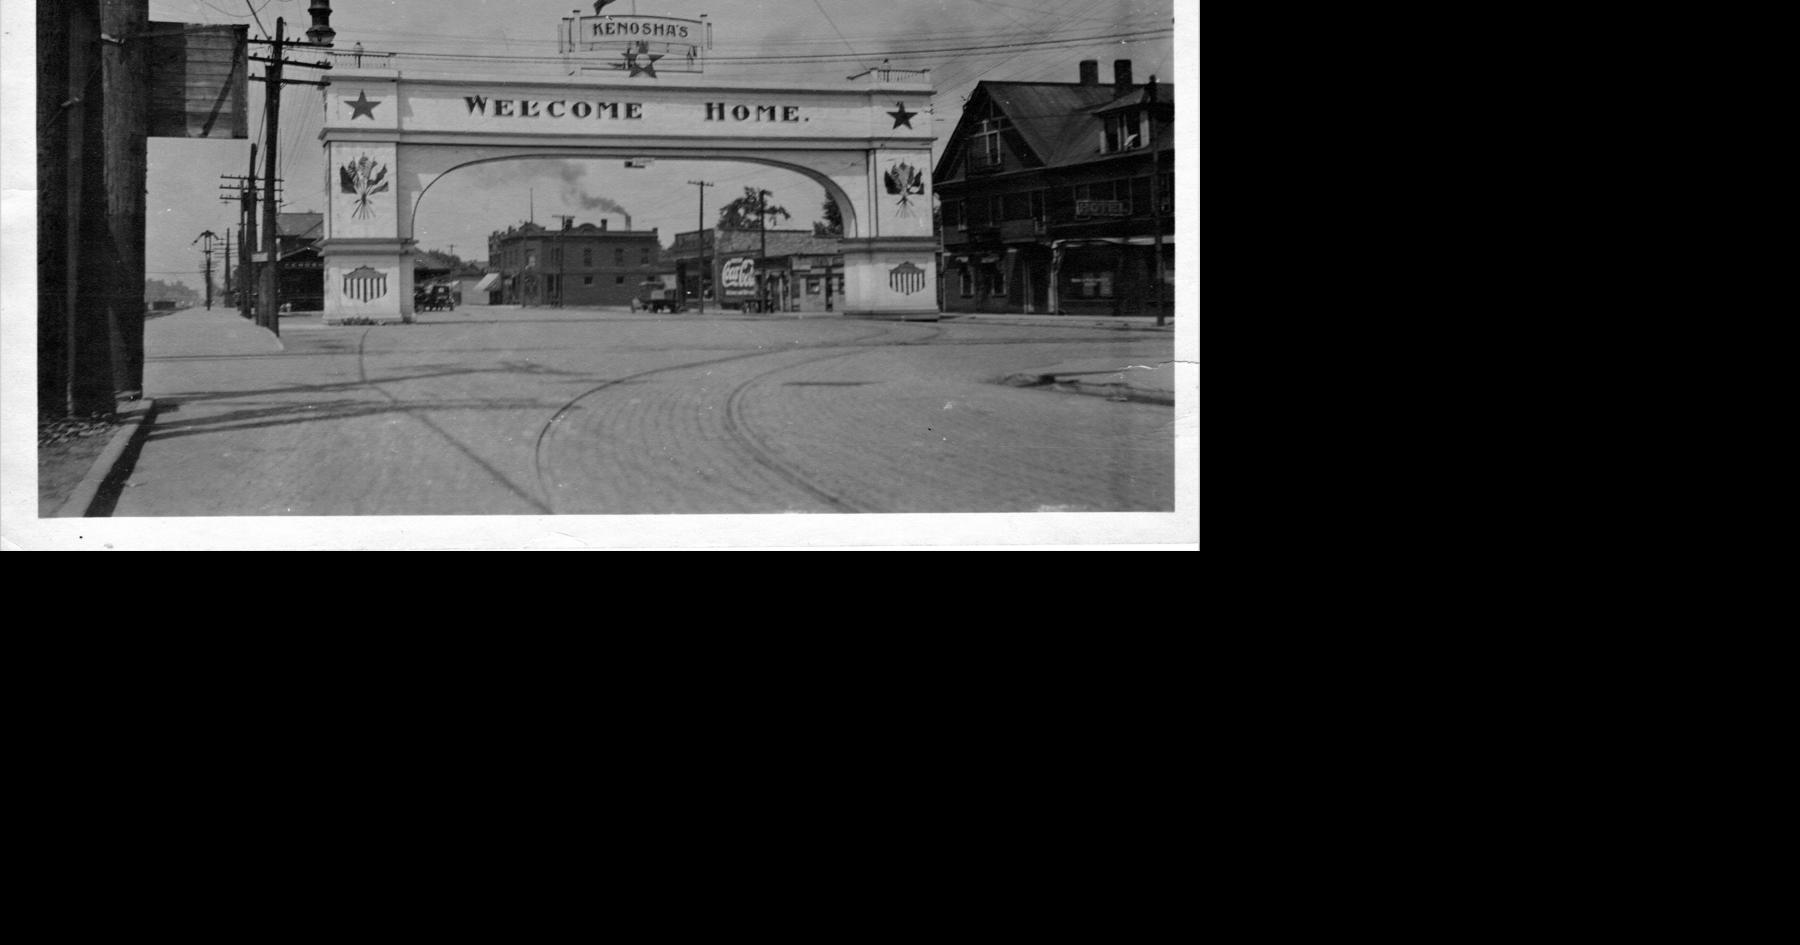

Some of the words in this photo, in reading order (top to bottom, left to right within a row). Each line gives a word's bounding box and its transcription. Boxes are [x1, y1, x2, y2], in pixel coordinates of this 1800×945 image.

[593, 22, 689, 38] KENOSHA'S
[464, 94, 643, 120] WELCOME
[704, 101, 810, 122] HOME.
